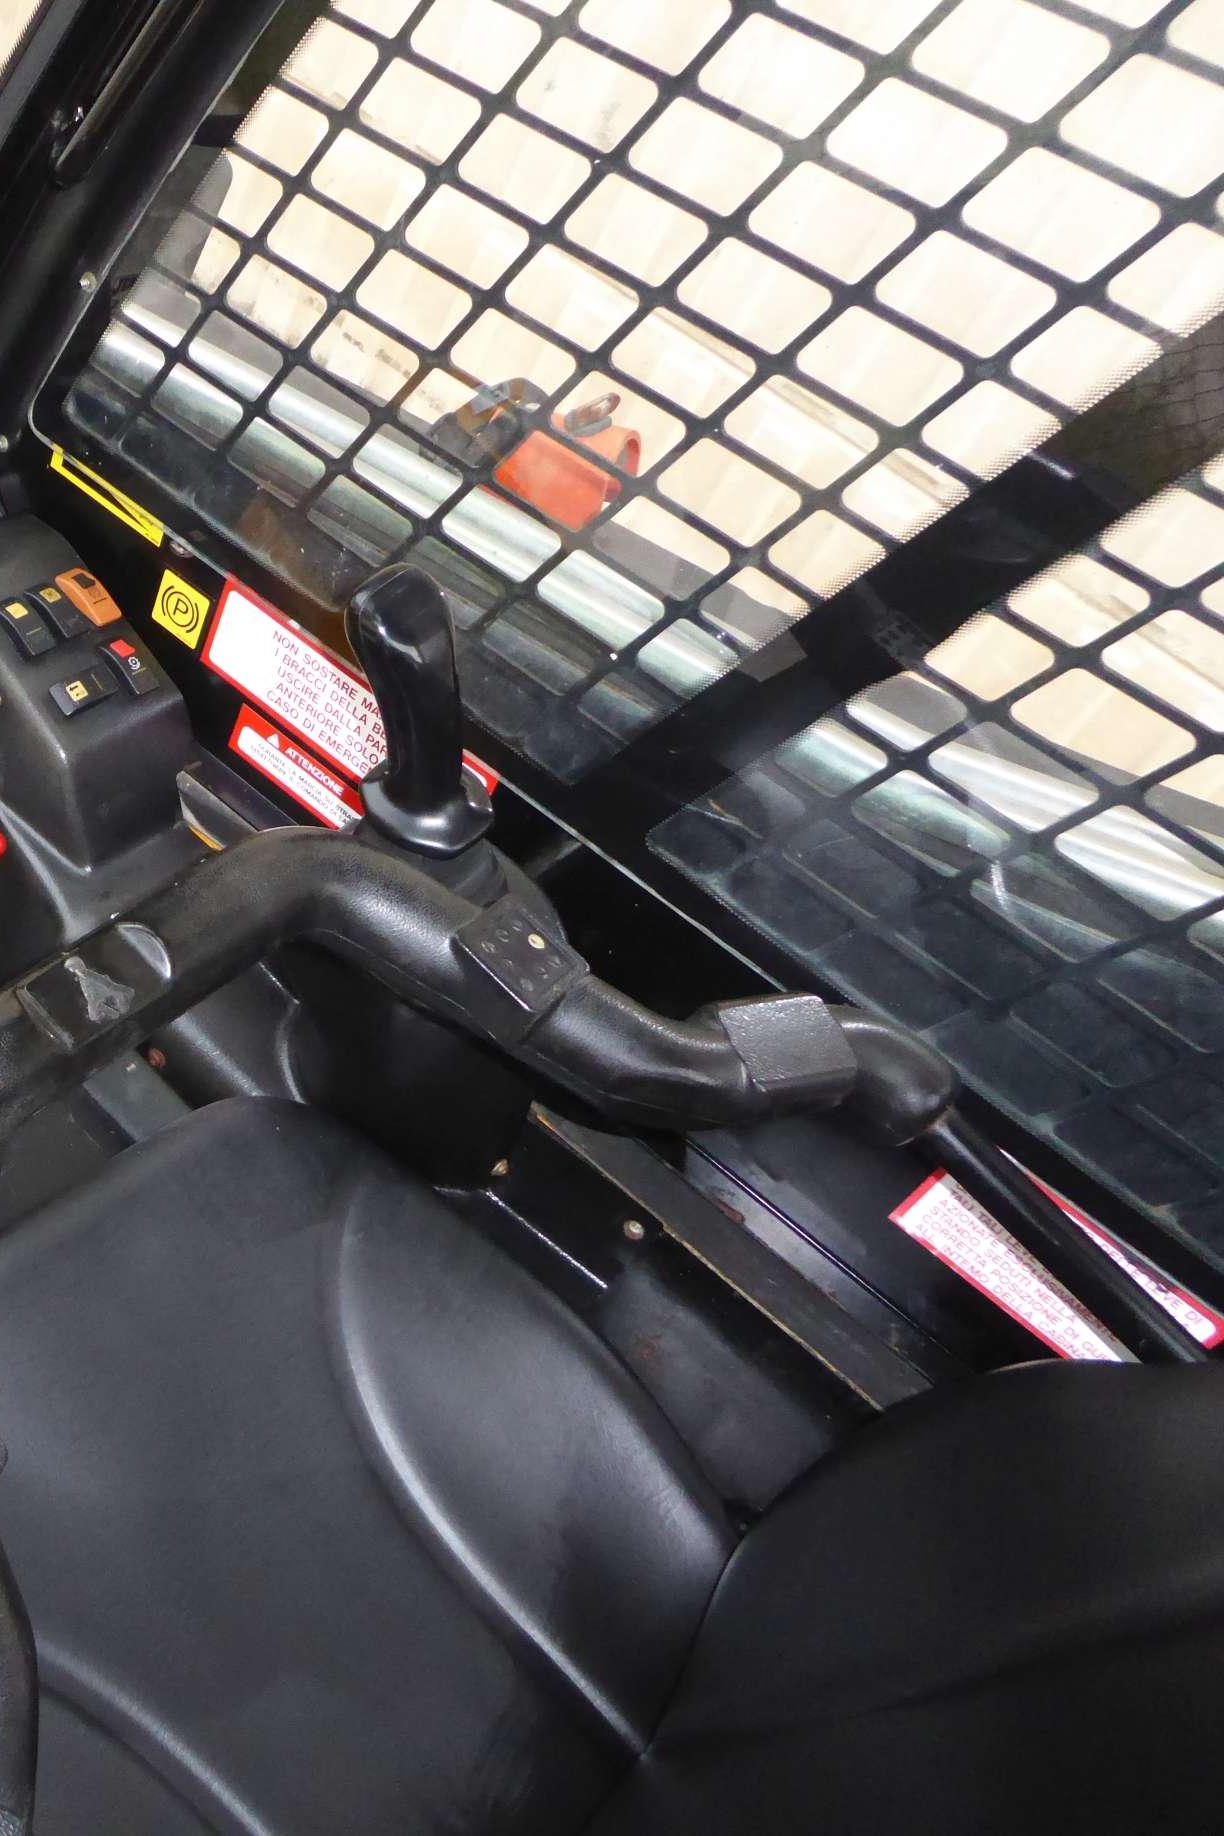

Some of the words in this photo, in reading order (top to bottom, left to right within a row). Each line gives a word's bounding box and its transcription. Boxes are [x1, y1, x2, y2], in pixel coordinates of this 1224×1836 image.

[173, 598, 189, 616] P
[273, 630, 299, 655] NON
[303, 654, 358, 700] SOSTARE
[361, 698, 383, 719] MA
[277, 667, 320, 704] USCIRE
[325, 703, 362, 736] DALLA
[366, 734, 387, 755] PAR
[283, 654, 326, 692] BRACCI
[330, 691, 369, 725] DELLA
[266, 690, 299, 720] CASO
[303, 719, 314, 731] DI
[319, 731, 370, 775] EMERGE
[277, 683, 341, 736] ANTERIORE
[345, 735, 378, 765] SOLO
[286, 749, 344, 795] ATTENZIONE
[940, 1198, 999, 1246] AZIONATE
[923, 1215, 987, 1266] CORRETTA
[991, 1269, 1059, 1323] POSIZIONE
[1064, 1327, 1078, 1340] DI
[930, 1207, 979, 1246] STANDO
[986, 1250, 1029, 1285] SEDUTI
[1035, 1289, 1075, 1321] NELLA
[994, 1285, 1032, 1317] DELLA
[1185, 1310, 1202, 1325] DI
